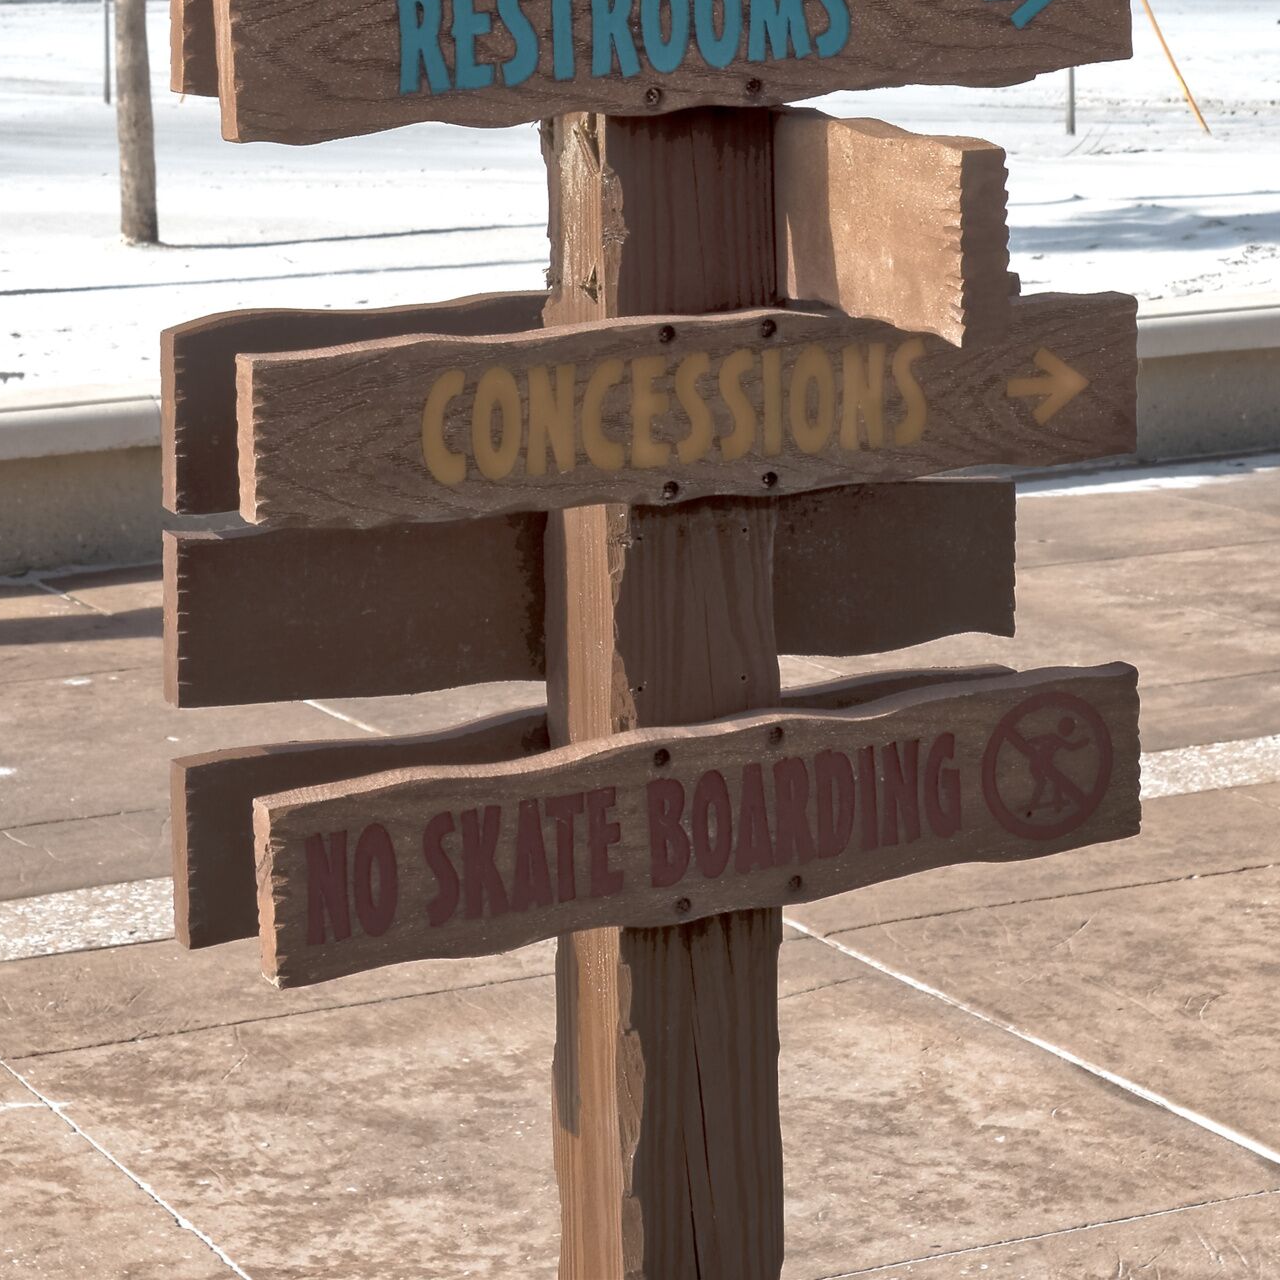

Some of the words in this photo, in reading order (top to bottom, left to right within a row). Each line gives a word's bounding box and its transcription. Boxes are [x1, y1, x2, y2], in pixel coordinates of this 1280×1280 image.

[423, 341, 927, 484] CONCESSIONS
[306, 823, 399, 945] NO
[424, 789, 625, 924] SKATE
[649, 732, 961, 888] BOARDING
